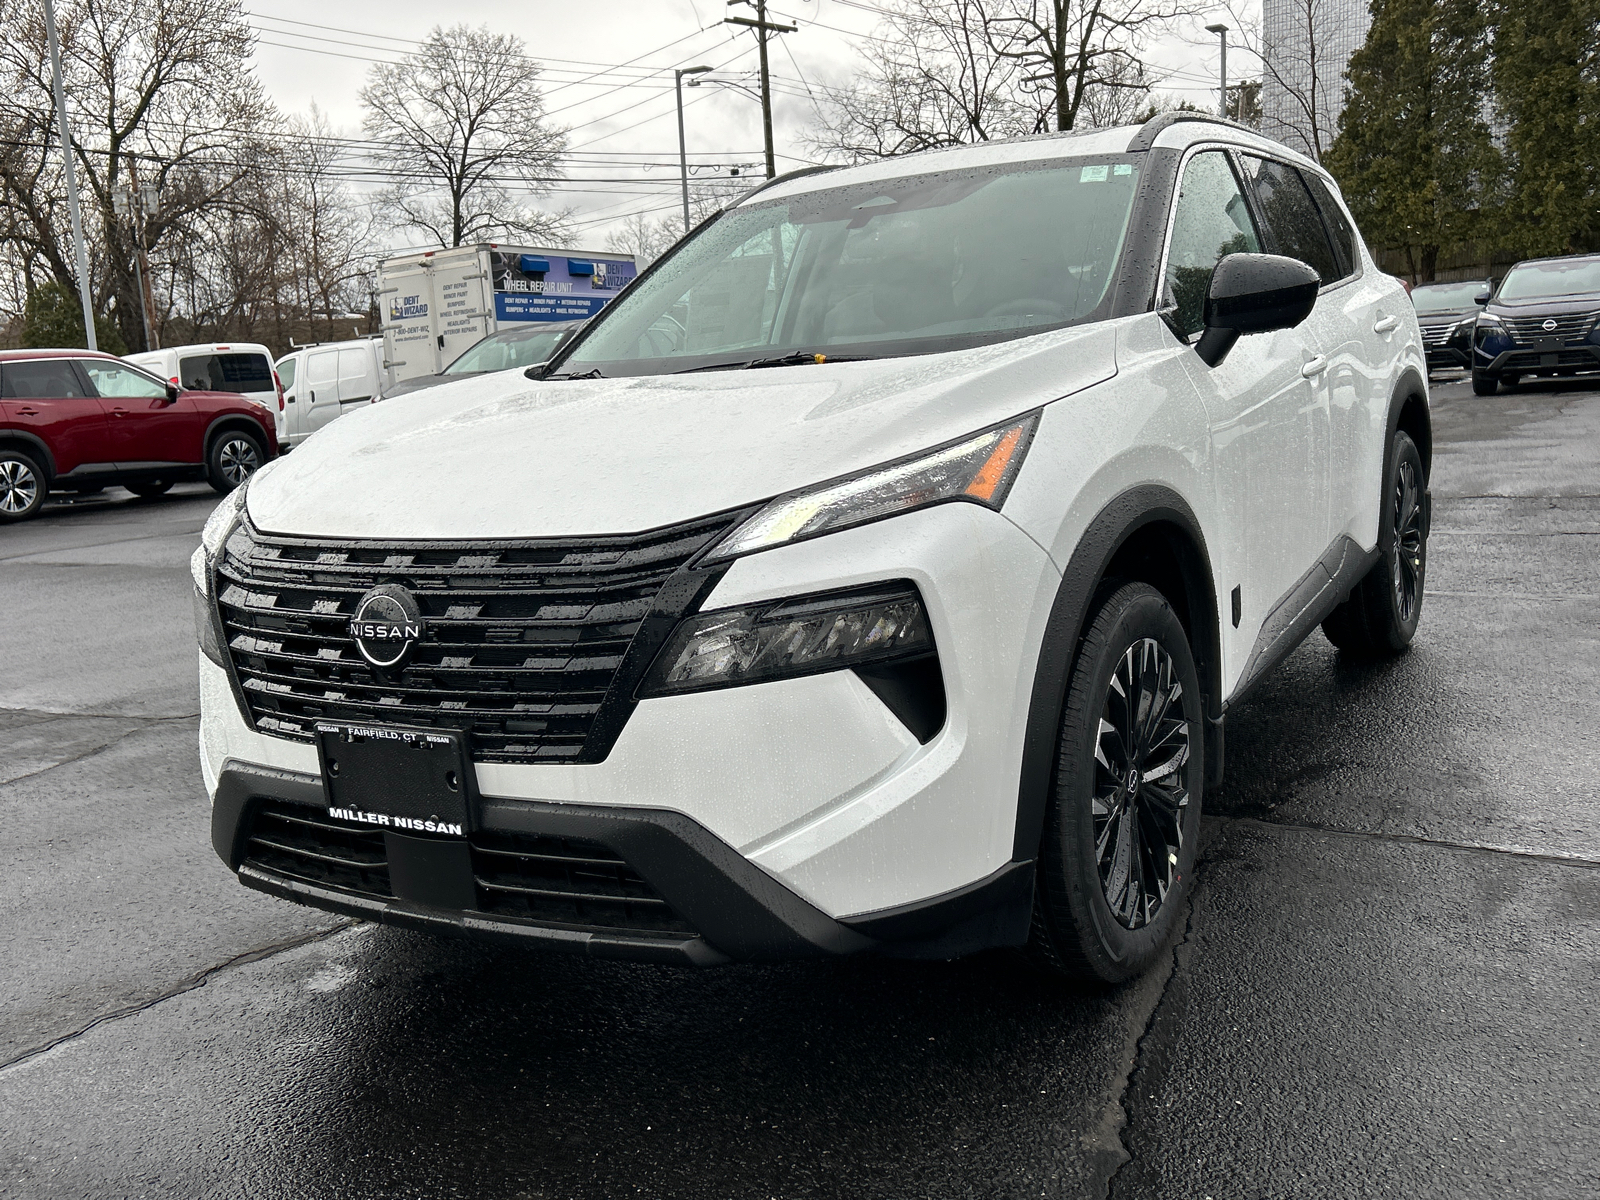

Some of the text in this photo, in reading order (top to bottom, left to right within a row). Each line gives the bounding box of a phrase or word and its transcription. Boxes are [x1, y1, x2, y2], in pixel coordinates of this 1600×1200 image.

[607, 264, 624, 275] DENT
[503, 279, 573, 293] WHEEL REPAIR UNIT
[403, 295, 420, 306] DENT
[403, 304, 428, 316] WIZARD
[447, 318, 471, 327] HEADLIGHTS
[461, 326, 477, 334] REPAIRS
[350, 623, 419, 638] NISSAN
[317, 725, 450, 744] NISSAN FAIRFIELD, CT NISSAN
[329, 807, 462, 836] MILLER NISSAN
